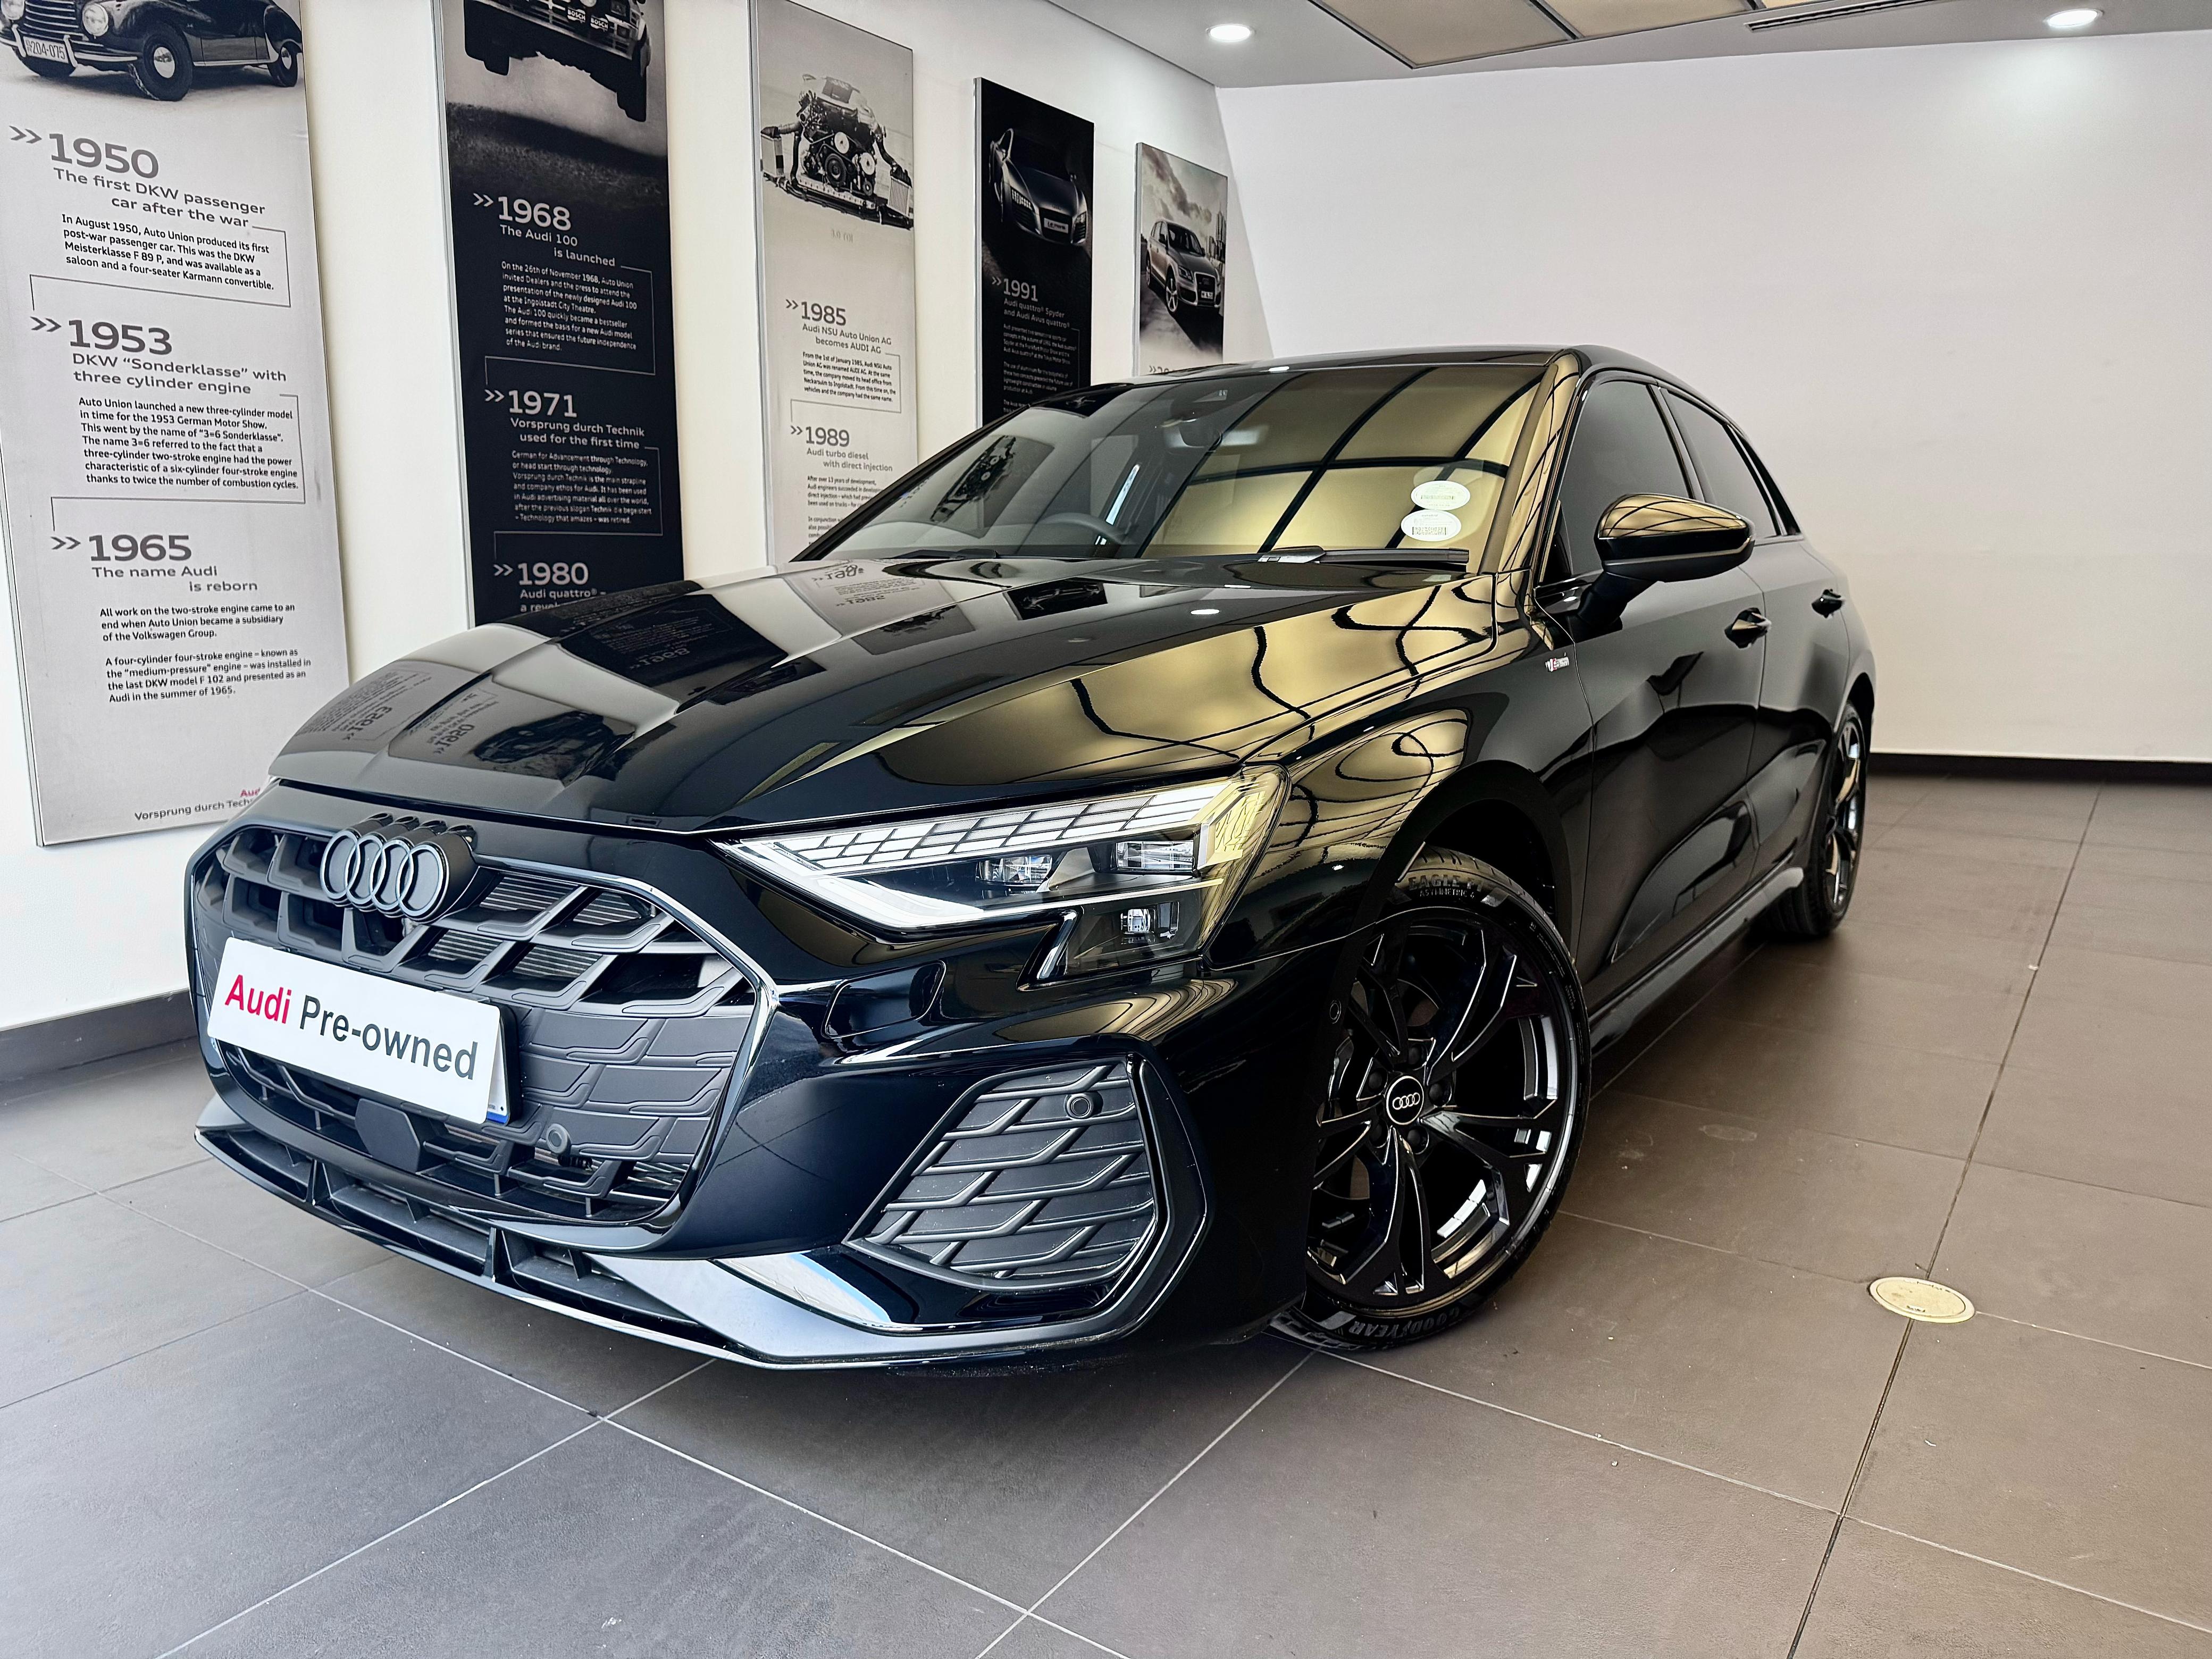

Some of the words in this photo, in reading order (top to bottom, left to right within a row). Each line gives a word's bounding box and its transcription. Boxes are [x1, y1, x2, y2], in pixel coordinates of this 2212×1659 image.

[49, 133, 160, 179] 1950
[53, 167, 87, 185] The
[94, 175, 130, 192] first
[136, 182, 178, 199] DKW
[184, 193, 265, 214] passenger
[111, 198, 137, 209] car
[143, 202, 183, 217] after
[188, 208, 215, 222] the
[219, 215, 248, 227] war
[498, 196, 572, 231] 1968
[62, 213, 72, 224] In
[75, 216, 110, 230] August
[113, 222, 141, 236] 1950,
[144, 227, 165, 238] Auto
[167, 230, 195, 242] Union
[196, 237, 237, 248] produced
[239, 240, 250, 250] its
[252, 242, 269, 253] first
[499, 224, 522, 237] The
[525, 229, 552, 242] Audi
[556, 233, 578, 246] 100
[63, 229, 107, 242] post-war
[109, 236, 157, 250] passenger
[159, 244, 175, 252] car.
[177, 244, 196, 255] This
[197, 249, 215, 258] was
[217, 250, 231, 260] the
[233, 252, 255, 263] DKW
[64, 240, 131, 258] Meisterklasse
[133, 250, 139, 259] F
[141, 252, 154, 262] 89
[156, 254, 164, 265] P,
[166, 257, 183, 266] and
[185, 259, 203, 269] was
[204, 262, 242, 274] available
[554, 247, 563, 257] is
[566, 249, 615, 266] launched
[66, 255, 98, 267] saloon
[101, 261, 119, 270] and
[129, 262, 180, 278] four-seater
[182, 270, 222, 283] Karmann
[224, 277, 274, 290] convertible.
[501, 261, 511, 270] On
[524, 264, 540, 273] 26th
[549, 268, 581, 280] November
[582, 273, 600, 284] 1968,
[601, 276, 616, 286] Auto
[616, 279, 633, 288] Union
[1003, 278, 1038, 303] 1991
[511, 295, 523, 304] the
[524, 296, 557, 308] Ingolstadt
[558, 301, 570, 312] City
[572, 303, 596, 314] Theatre.
[801, 301, 847, 326] 1985
[1003, 297, 1018, 307] Audi
[1045, 307, 1065, 318] Spyder
[1016, 310, 1030, 320] Audi
[1030, 314, 1045, 323] Avus
[68, 319, 173, 355] 1953
[802, 323, 820, 333] Audi
[821, 326, 838, 336] NSU
[839, 329, 858, 339] Auto
[858, 332, 879, 343] Union
[881, 336, 892, 345] AG
[815, 336, 849, 348] becomes
[850, 341, 869, 352] AUDI
[870, 345, 881, 354] AG
[72, 353, 118, 367] DKW
[253, 370, 286, 381] with
[73, 370, 121, 384] three
[126, 375, 193, 389] cylinder
[198, 381, 251, 395] engine
[79, 397, 102, 406] Auto
[104, 398, 132, 409] Union
[135, 400, 176, 412] launched
[206, 405, 265, 417] three-cylinder
[267, 409, 292, 419] model
[508, 390, 577, 418] 1971
[91, 410, 114, 420] time
[116, 411, 130, 421] for
[132, 412, 148, 422] the
[151, 414, 174, 423] 1953
[177, 415, 212, 425] German
[214, 417, 240, 428] Motor
[242, 419, 267, 429] Show.
[510, 417, 570, 433] Vorsprung
[573, 422, 604, 433] durch
[605, 424, 644, 437] Technik
[520, 433, 547, 442] used
[550, 433, 567, 443] for
[569, 435, 588, 445] the
[590, 436, 613, 447] first
[615, 438, 640, 449] time
[805, 426, 850, 447] 1989
[806, 447, 824, 456] Audi
[847, 451, 869, 460] diesel
[823, 459, 840, 468] with
[841, 461, 862, 470] direct
[863, 462, 893, 472] injection
[88, 534, 192, 562] 1965
[91, 566, 124, 577] The
[129, 568, 176, 577] name
[181, 565, 217, 576] Audi
[517, 562, 589, 585] 1980
[189, 581, 202, 591] is
[206, 580, 257, 591] reborn
[520, 588, 546, 599] Audi
[103, 632, 113, 641] of
[115, 632, 131, 641] the
[132, 630, 186, 641] Volkswagen
[188, 629, 217, 639] Group.
[109, 692, 130, 702] Audi
[132, 692, 141, 701] in
[143, 691, 158, 700] the
[160, 689, 197, 699] summer
[199, 686, 208, 696] of
[211, 685, 236, 695] 1965.
[134, 806, 191, 820] Vorsprung
[194, 800, 224, 812] durch
[224, 974, 292, 1025] Audi
[299, 994, 478, 1080] Pre-owned
